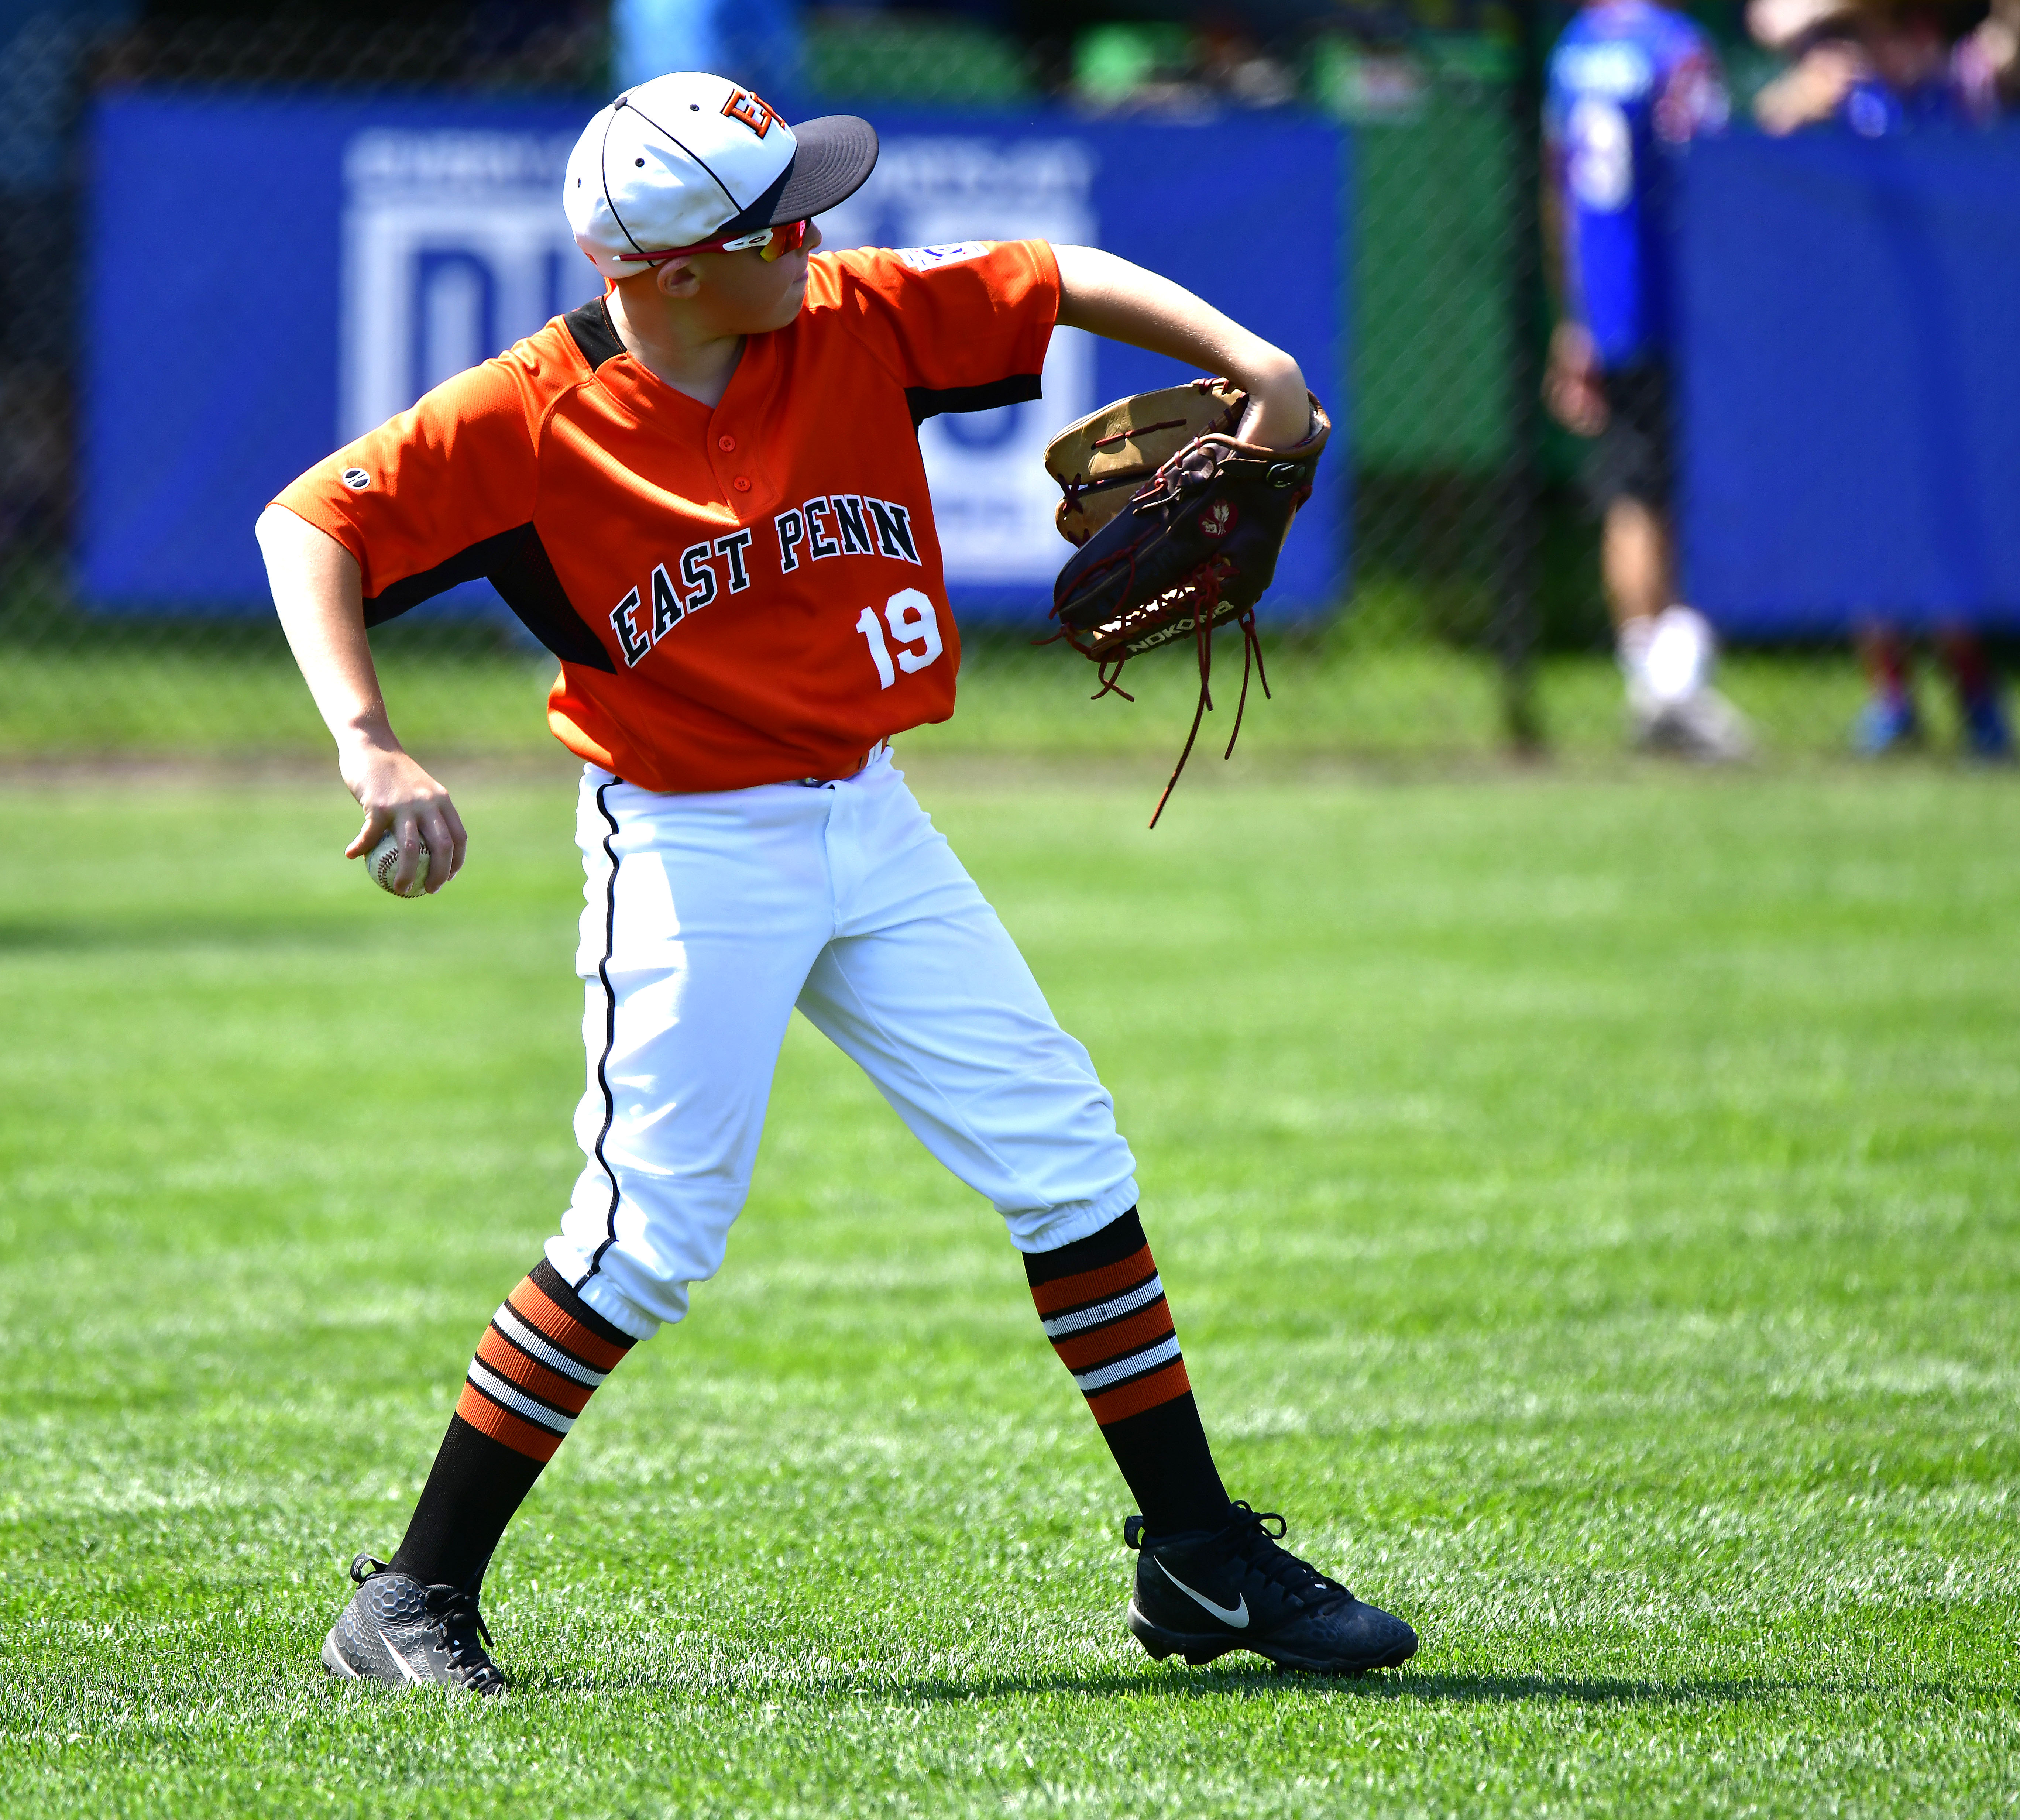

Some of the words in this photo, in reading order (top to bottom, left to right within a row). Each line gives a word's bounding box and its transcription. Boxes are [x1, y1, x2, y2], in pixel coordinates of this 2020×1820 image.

[720, 89, 785, 140] E
[609, 528, 752, 669] EAST
[774, 494, 922, 574] PENN
[856, 587, 943, 690] 19
